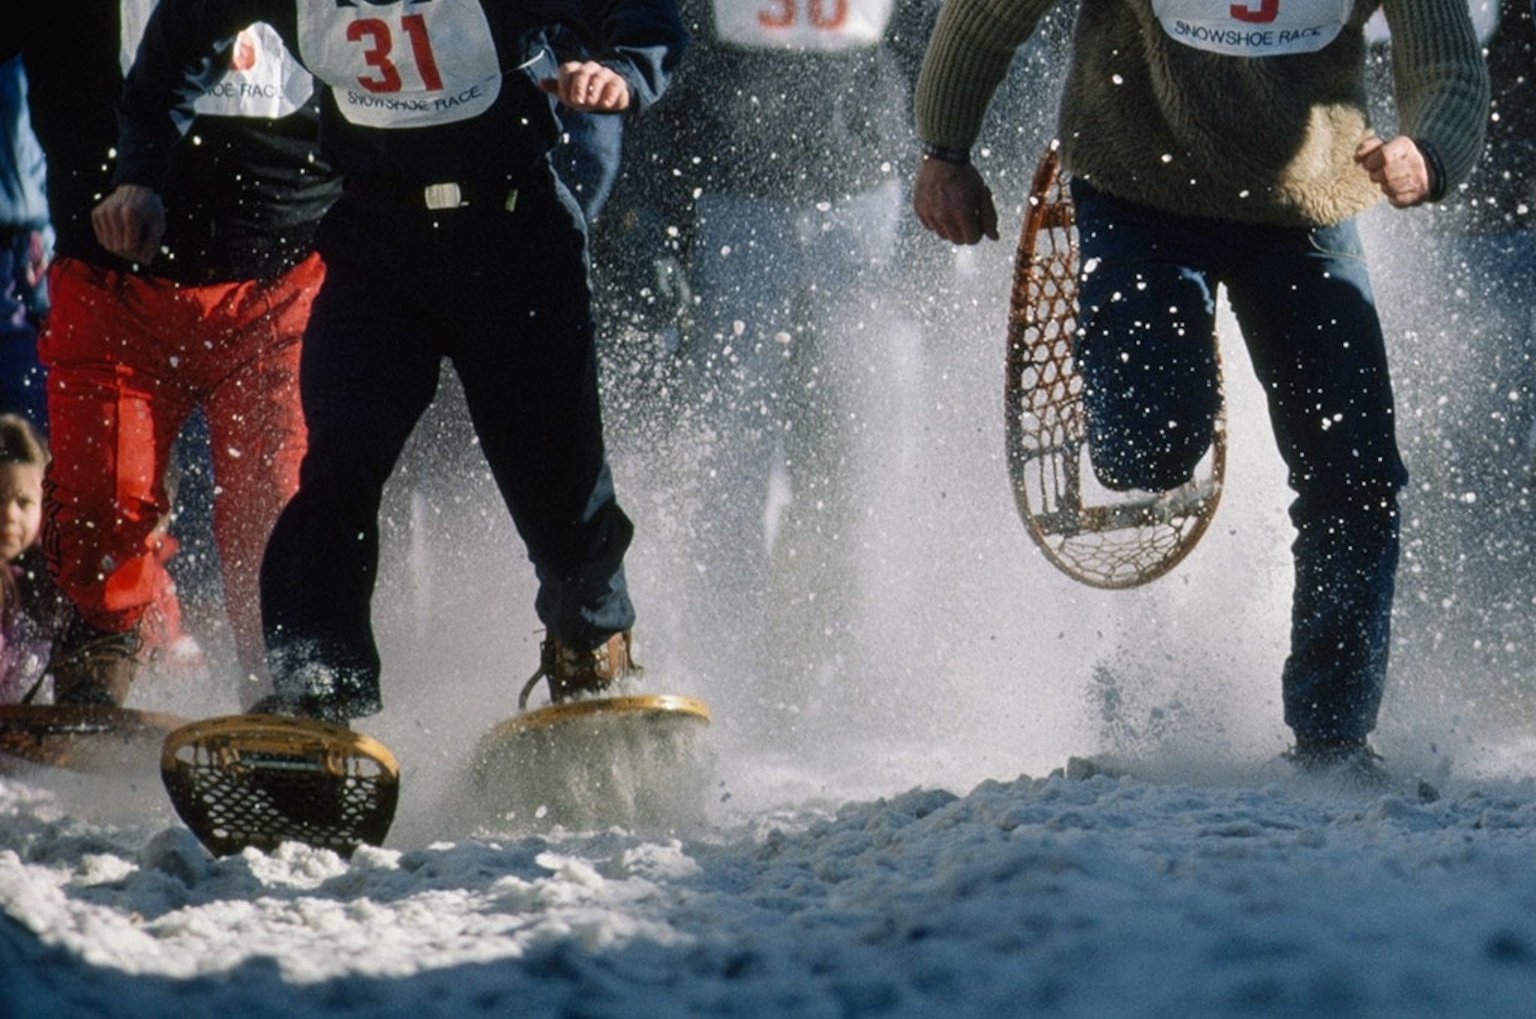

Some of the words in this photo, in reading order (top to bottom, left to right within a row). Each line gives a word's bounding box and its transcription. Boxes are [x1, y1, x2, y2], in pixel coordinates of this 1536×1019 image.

[1174, 19, 1274, 47] SNOWSHOE
[1278, 24, 1323, 45] RACE
[346, 13, 445, 95] 31
[240, 83, 283, 99] RAC
[434, 85, 483, 112] RACE
